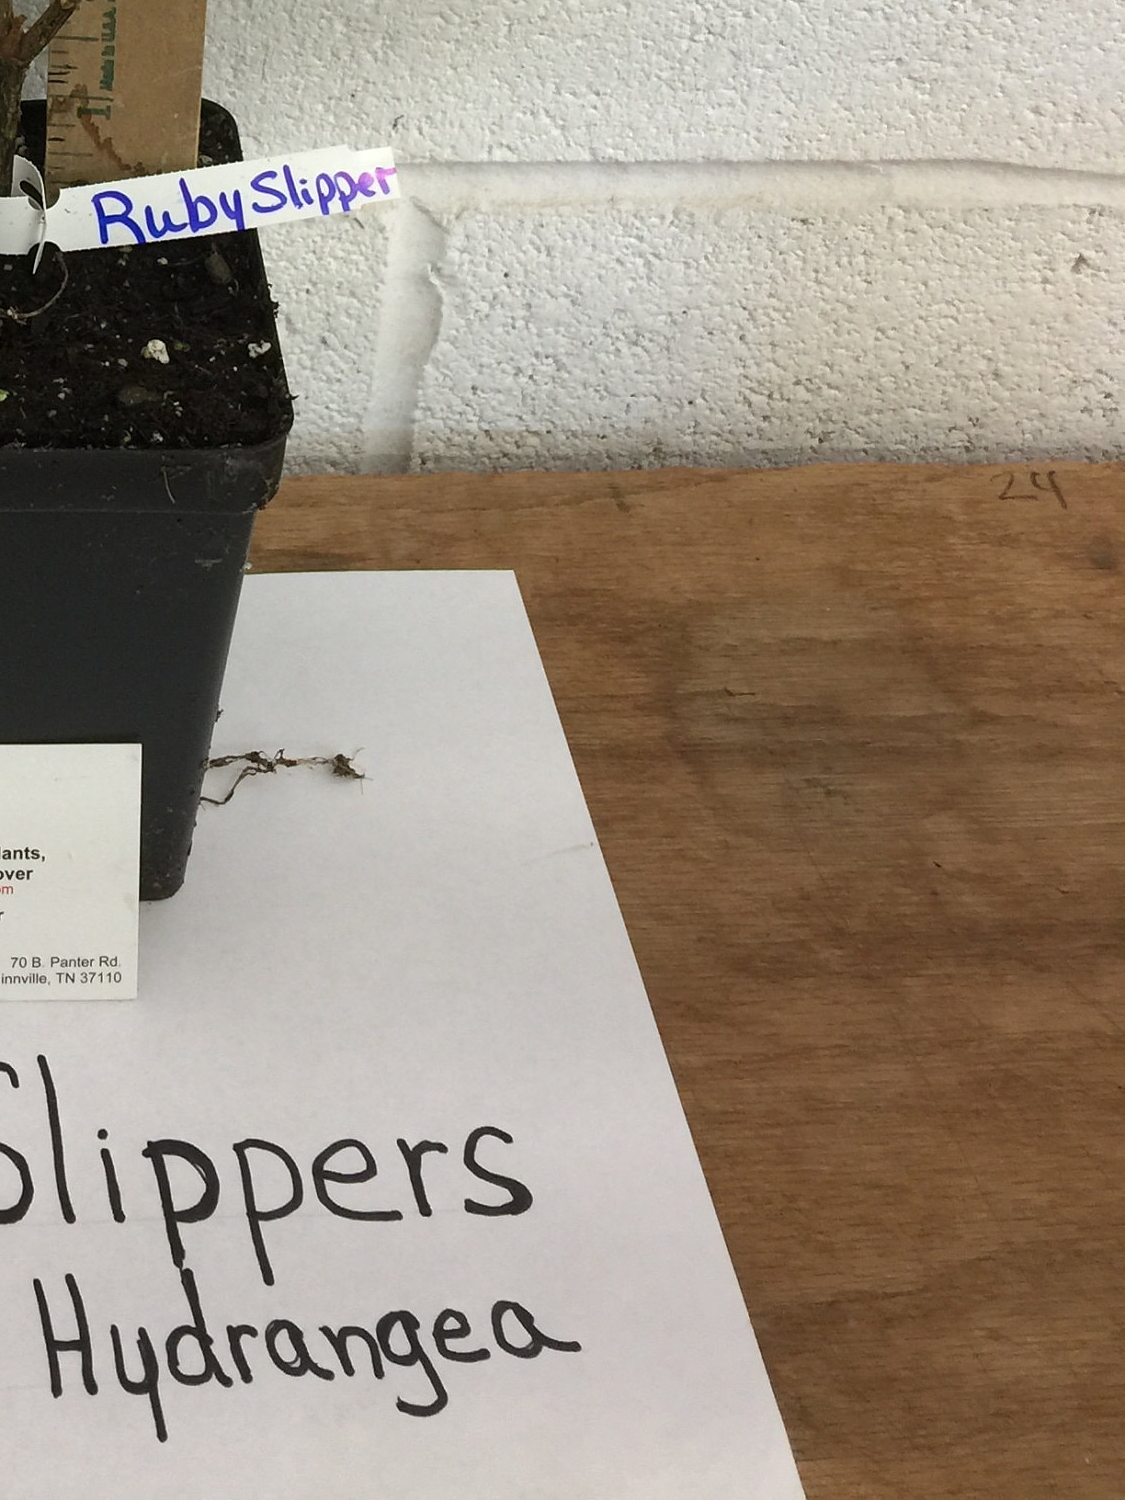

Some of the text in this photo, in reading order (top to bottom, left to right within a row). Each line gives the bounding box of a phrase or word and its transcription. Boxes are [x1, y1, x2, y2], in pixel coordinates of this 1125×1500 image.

[90, 163, 397, 245] Ruby Slipper
[10, 956, 28, 969] 70
[49, 955, 95, 969] Panter
[98, 955, 122, 968] Rd.
[56, 972, 76, 984] TN
[79, 971, 123, 984] 37110
[32, 1268, 582, 1443] Hydrangea
